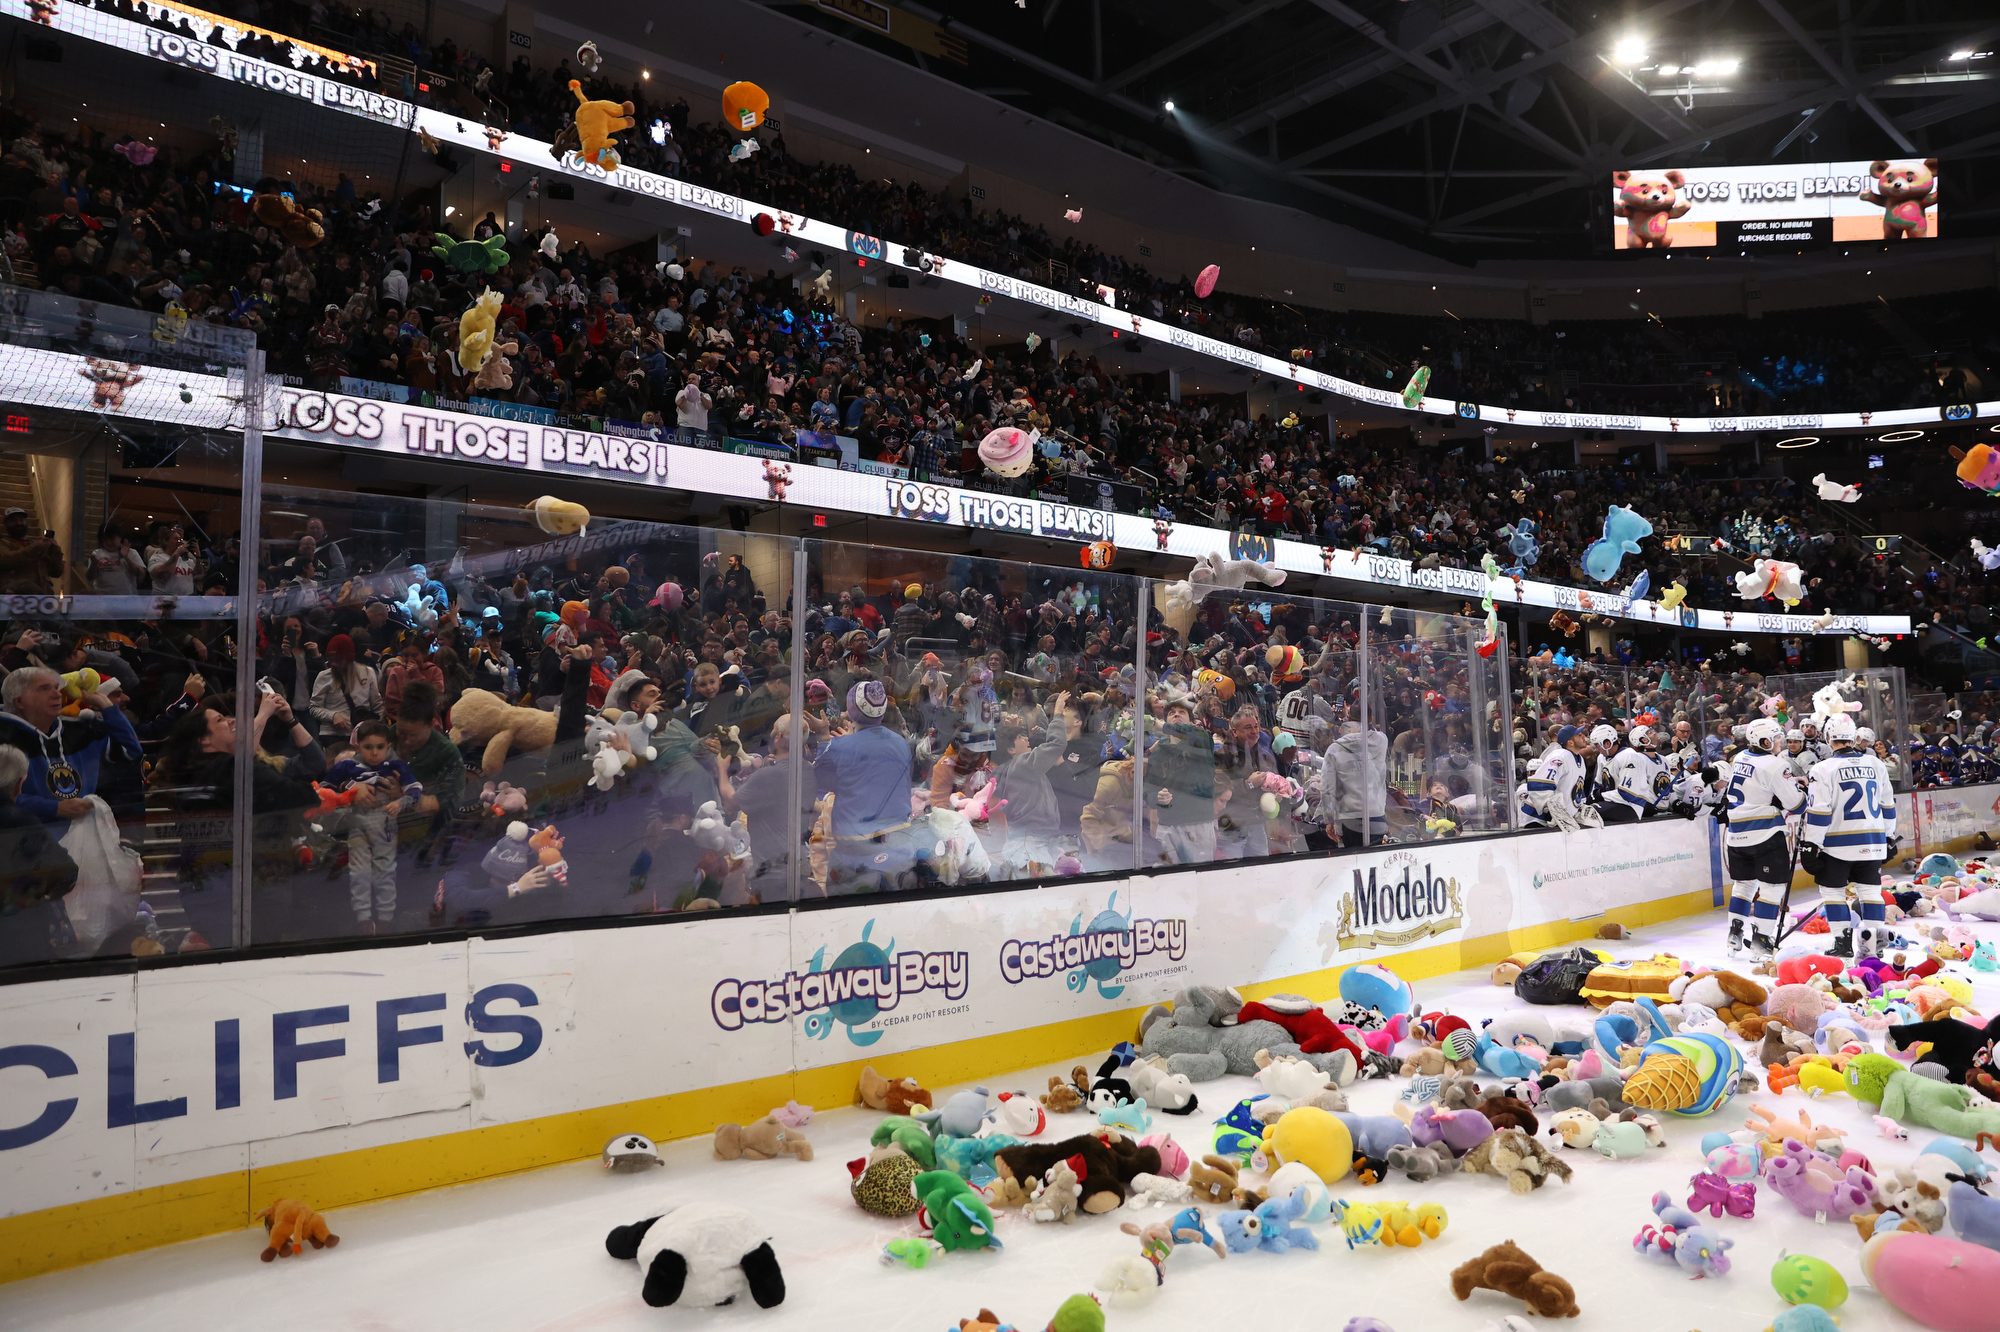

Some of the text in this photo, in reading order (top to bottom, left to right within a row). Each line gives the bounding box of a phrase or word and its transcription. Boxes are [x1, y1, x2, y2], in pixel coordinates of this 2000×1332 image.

[511, 32, 530, 47] 209
[145, 28, 218, 74] TOSS
[230, 56, 313, 99] THOSE
[429, 75, 447, 88] 209
[764, 118, 780, 131] 210
[616, 169, 674, 200] THOSE
[681, 184, 743, 217] BEARS!
[1684, 175, 1870, 201] TOSS THOSE BEARS!
[1742, 220, 1813, 231] ORDER. NO MINIMUM
[1738, 233, 1813, 243] PURCHASE REQUIRED.
[979, 269, 1011, 297] TOSS
[1016, 282, 1056, 310] THOSE
[1169, 327, 1194, 347] TOSS
[1197, 337, 1227, 359] THOSE
[1316, 373, 1337, 391] TOSS
[1339, 382, 1363, 400] THOSE
[1540, 412, 1566, 427] TOSS
[1570, 415, 1603, 429] THOSE
[1708, 417, 1737, 431] TOSS
[1742, 417, 1779, 431] THOSE
[273, 390, 669, 478] TOSS THOSE BEARS!
[667, 434, 691, 445] CLUB
[747, 444, 789, 461] Huntington
[864, 464, 884, 475] CLUB
[928, 472, 963, 487] Huntington
[973, 481, 992, 491] CLUB
[1037, 489, 1068, 503] Huntington
[886, 480, 1114, 540] TOSS THOSE BEARS!
[1369, 557, 1400, 580] TOSS
[1405, 565, 1444, 588] THOSE
[1554, 587, 1577, 606] TOSS
[1591, 595, 1607, 612] OSE
[1758, 614, 1783, 630] TOSS
[1786, 617, 1816, 632] THOS
[1840, 767, 1876, 780] KNAZKO
[1621, 777, 1633, 788] 14
[1689, 796, 1700, 806] 37
[1838, 780, 1881, 821] 20
[1384, 852, 1418, 868] CERVEZA
[1591, 866, 1600, 875] The
[1600, 863, 1616, 873] Official
[1617, 862, 1630, 871] Health
[1631, 860, 1645, 869] Insurer
[1646, 857, 1650, 867] of
[1658, 854, 1676, 864] Cleveland
[1676, 852, 1693, 861] Monsters
[1543, 869, 1588, 883] MEDICAL MUTUAL
[1353, 862, 1447, 928] Modelo
[1397, 934, 1411, 943] 1925
[1124, 974, 1143, 983] CEDAR
[1144, 970, 1162, 980] POINT
[1163, 965, 1188, 977] RESORTS
[871, 1004, 970, 1030] BY CEDAR POINT RESORTS
[0, 983, 543, 1151] CLIFFS
